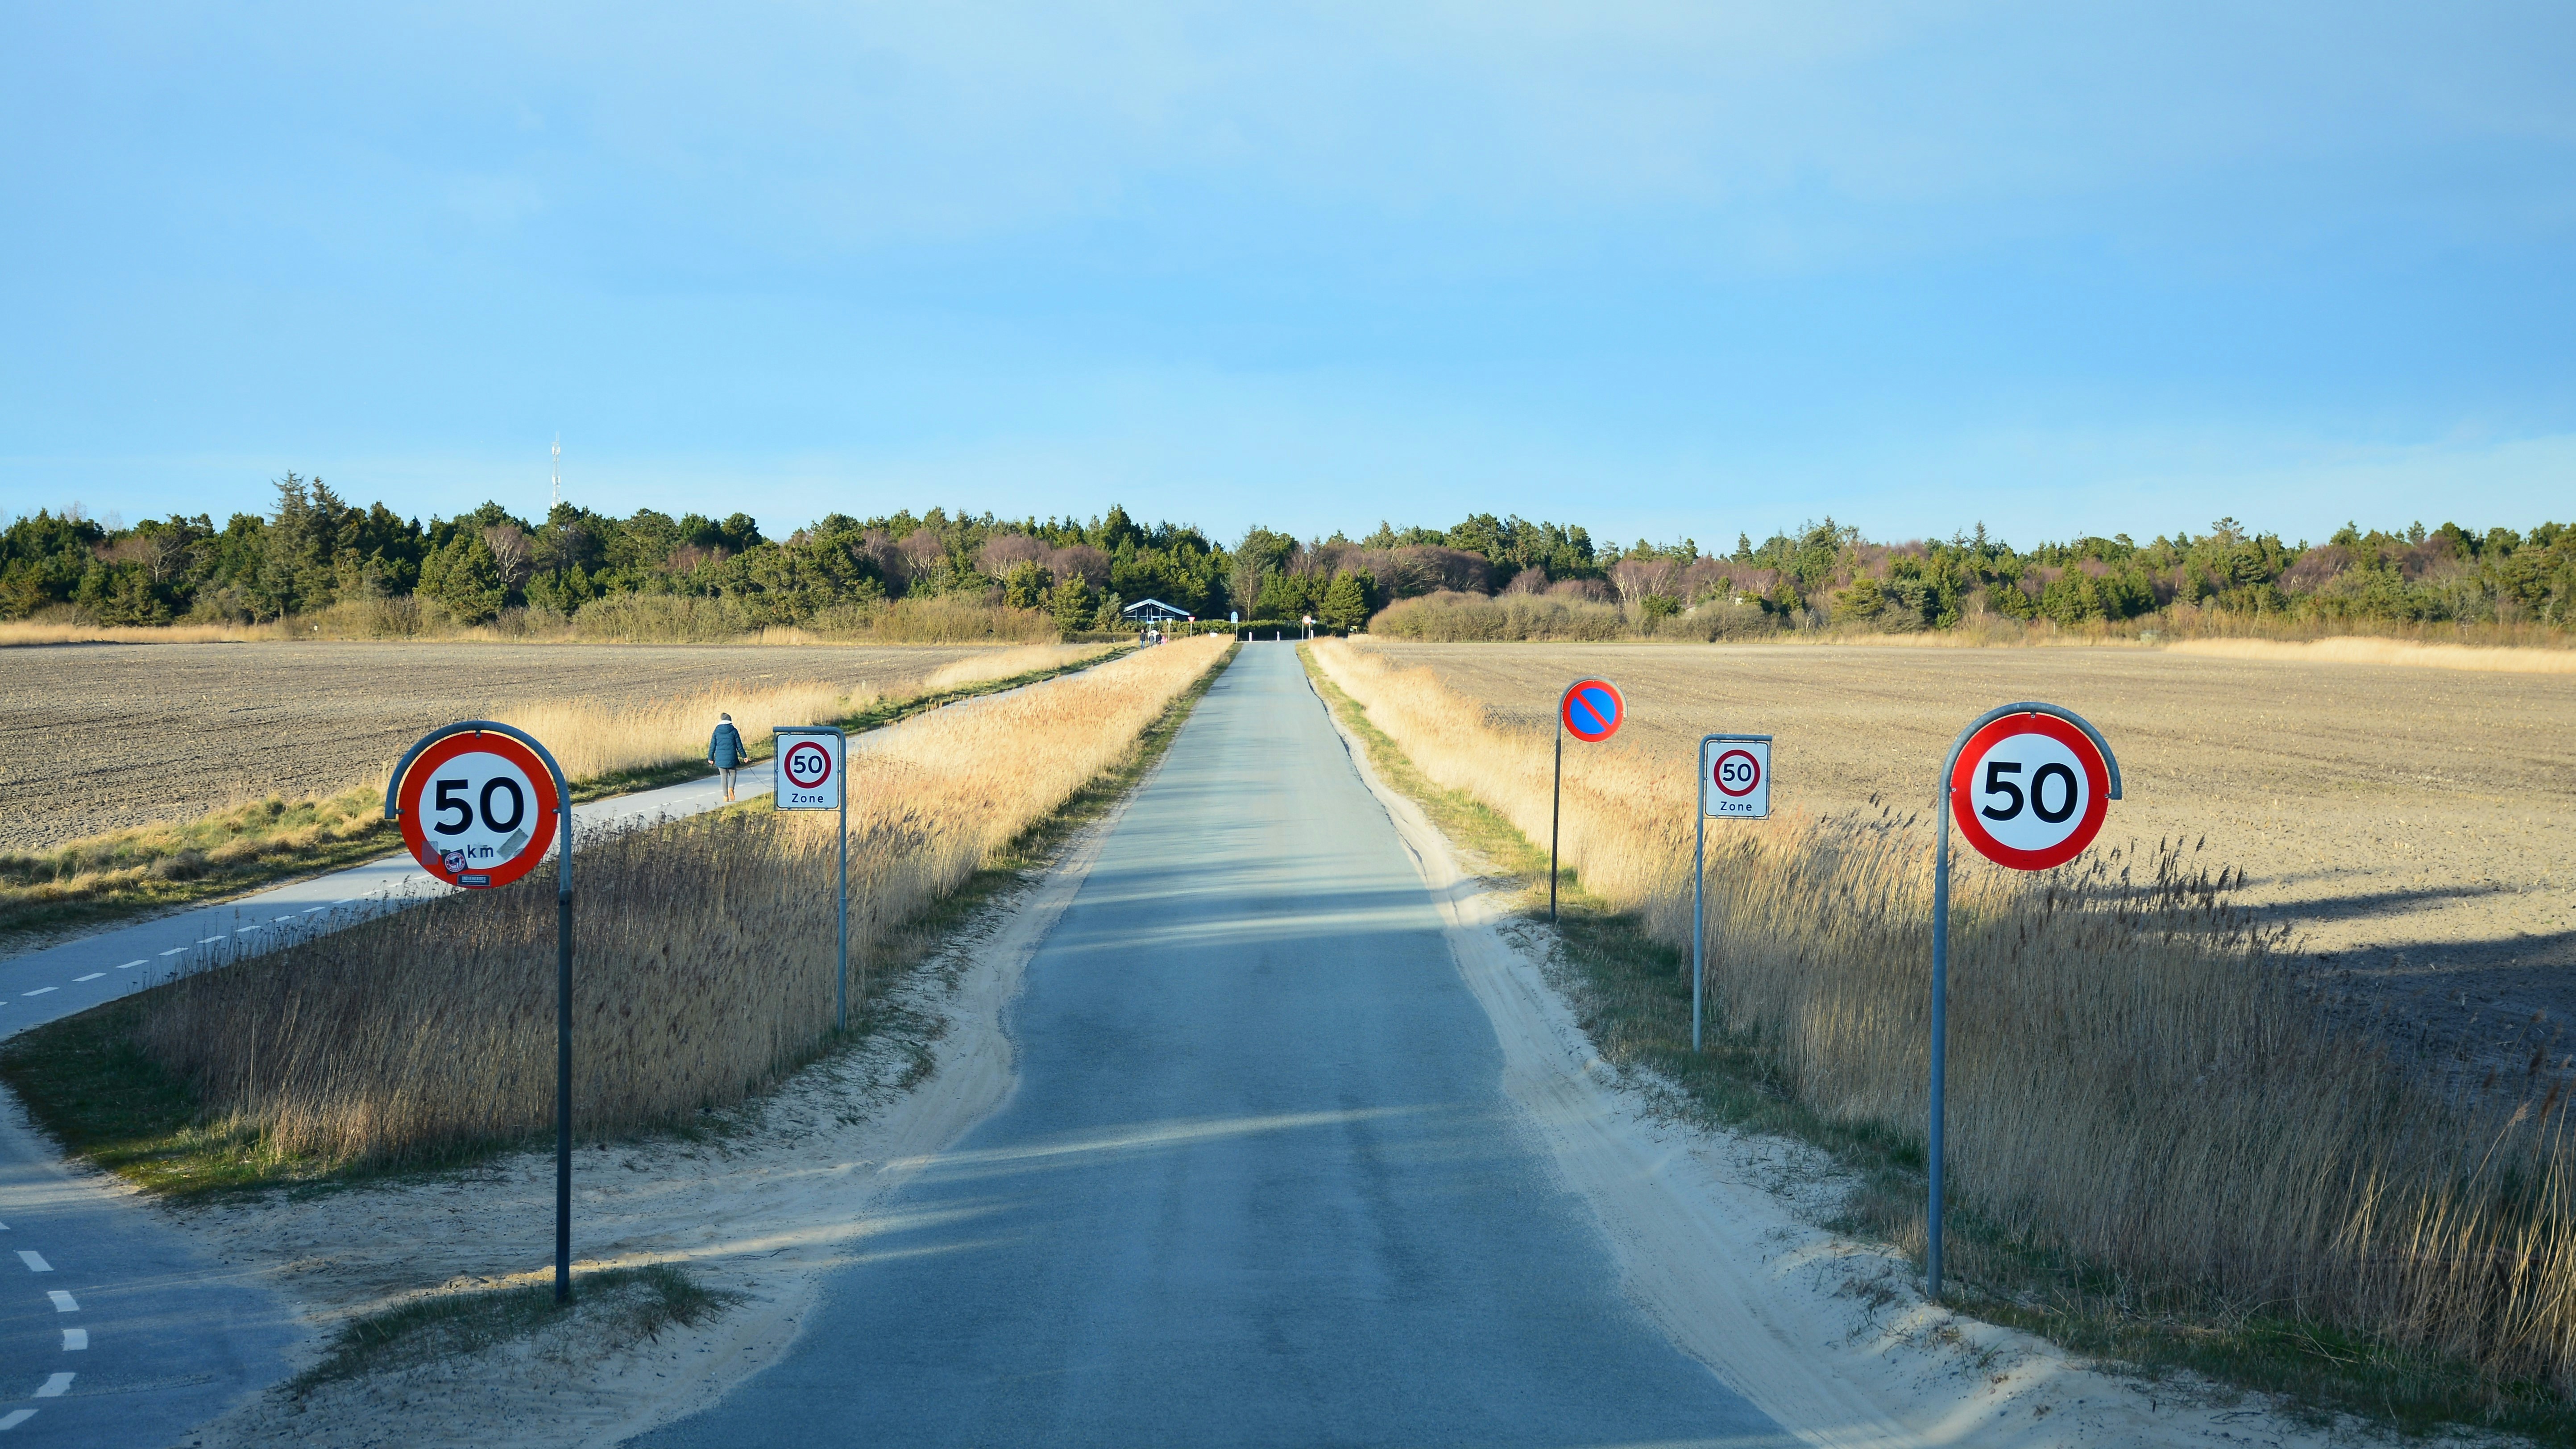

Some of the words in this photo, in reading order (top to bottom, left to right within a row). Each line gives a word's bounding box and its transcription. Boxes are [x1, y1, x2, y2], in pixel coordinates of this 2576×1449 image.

[793, 755, 823, 774] 50
[1722, 763, 1751, 782] 50
[792, 793, 824, 803] Zone
[1982, 762, 2078, 823] 50
[434, 777, 524, 835] 50
[1720, 801, 1752, 811] Zone
[467, 844, 494, 859] km
